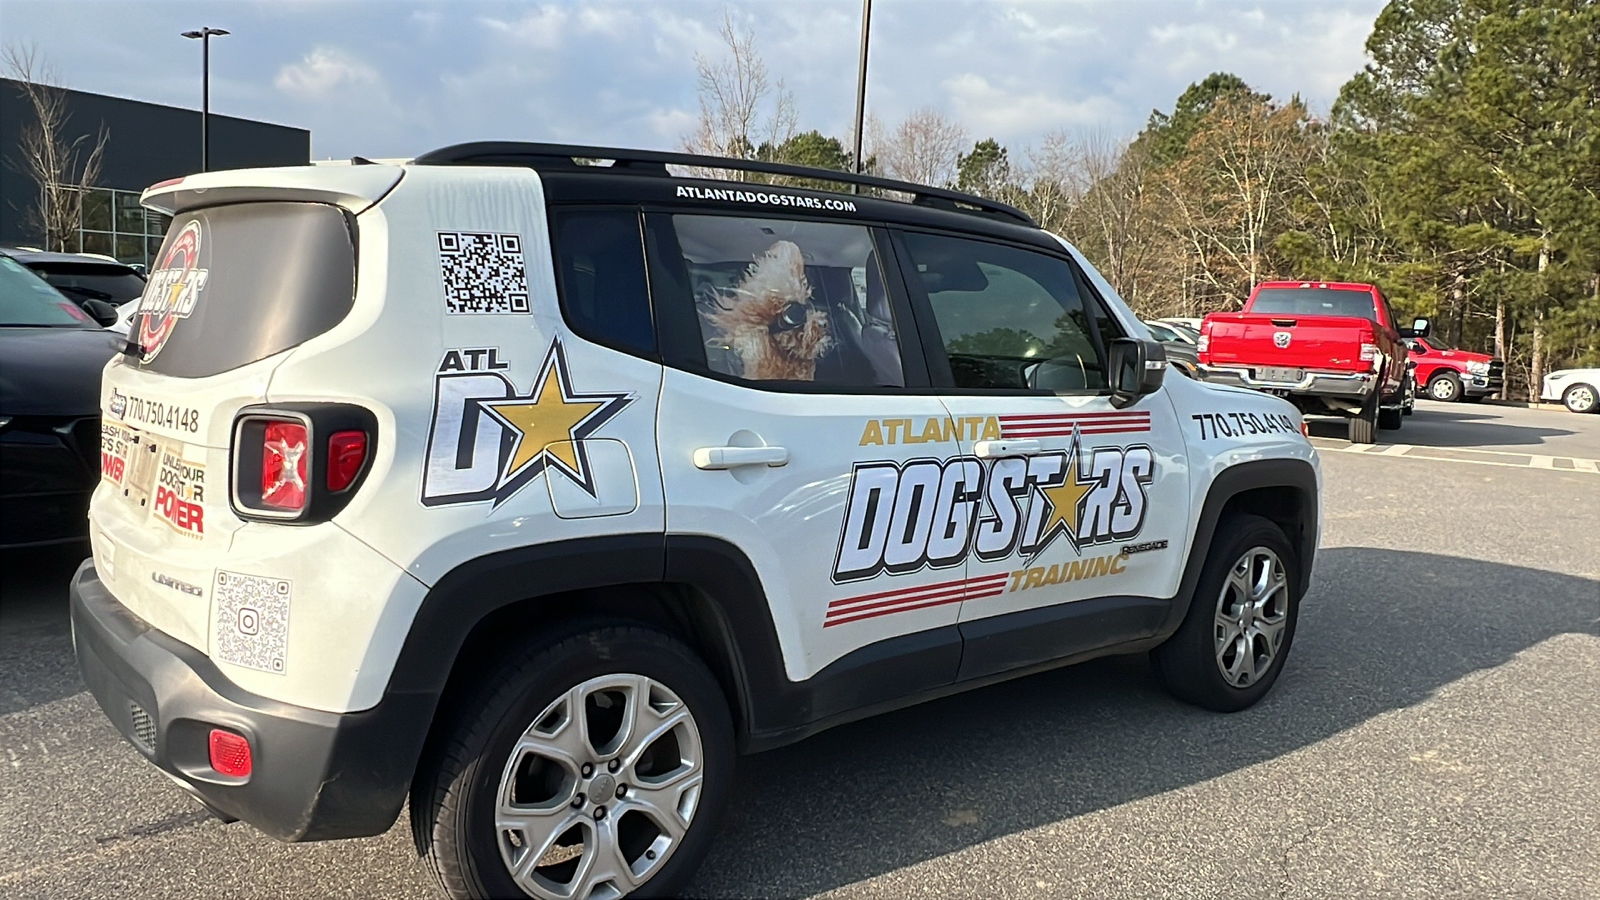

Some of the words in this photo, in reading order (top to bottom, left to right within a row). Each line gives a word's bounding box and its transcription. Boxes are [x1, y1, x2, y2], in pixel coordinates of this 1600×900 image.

[676, 186, 856, 212] ATLANTADOGSTARS.COM
[438, 350, 508, 371] ATL
[128, 396, 199, 433] 770.750.4148
[859, 416, 1002, 446] ATLANTA
